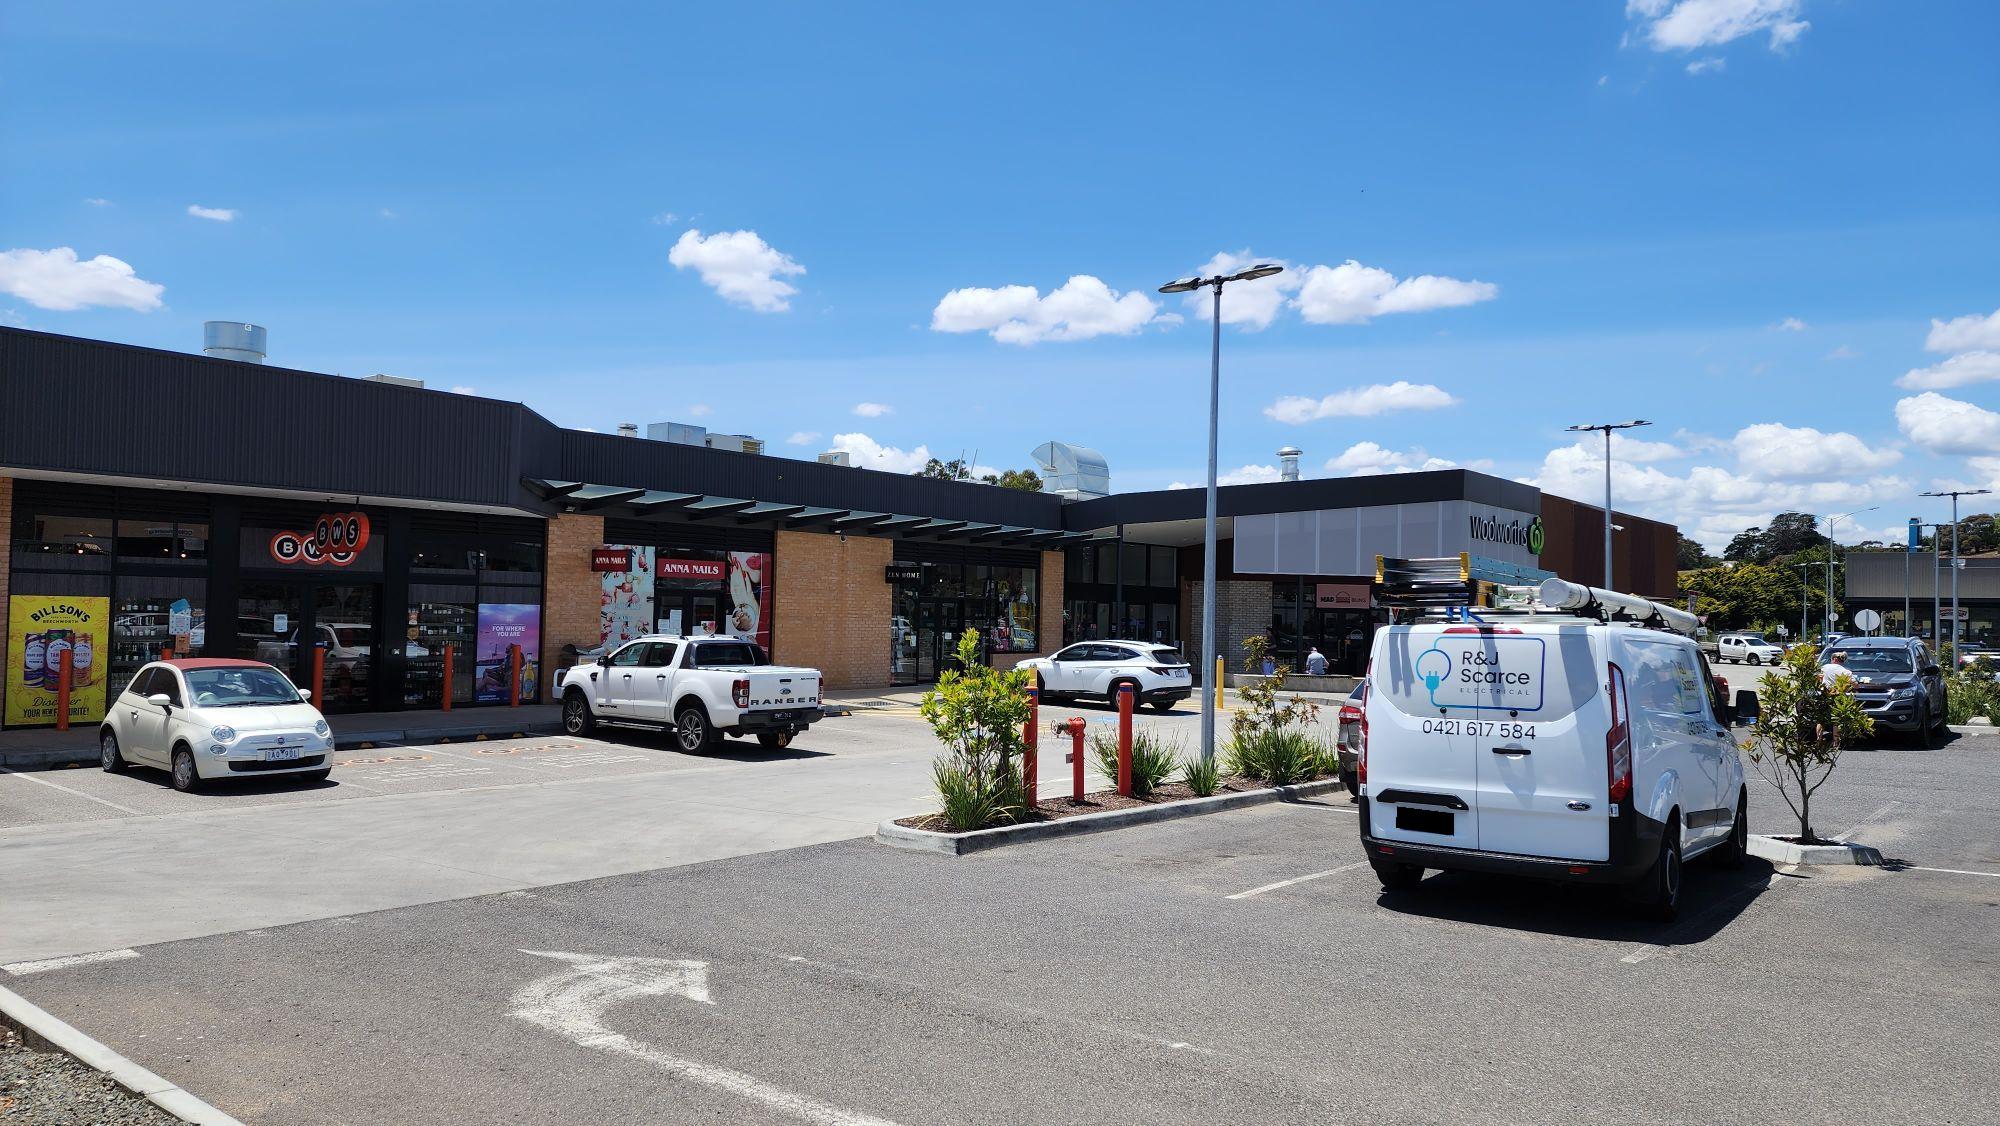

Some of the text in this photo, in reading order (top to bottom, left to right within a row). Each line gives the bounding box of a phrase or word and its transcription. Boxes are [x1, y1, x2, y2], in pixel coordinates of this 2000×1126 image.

[320, 524, 355, 540] BWS
[1470, 515, 1527, 546] Woolworths
[610, 557, 626, 565] NAILS
[664, 564, 719, 575] ANNA NAILS
[30, 604, 91, 623] BILLSON'S
[1462, 651, 1499, 665] R&J
[1460, 668, 1530, 685] Scarce
[1460, 688, 1531, 696] ELECTRICAL
[32, 696, 82, 707] Discer
[751, 697, 816, 705] RANGER
[23, 708, 40, 718] YOUR
[1422, 720, 1536, 740] 0421 617 584
